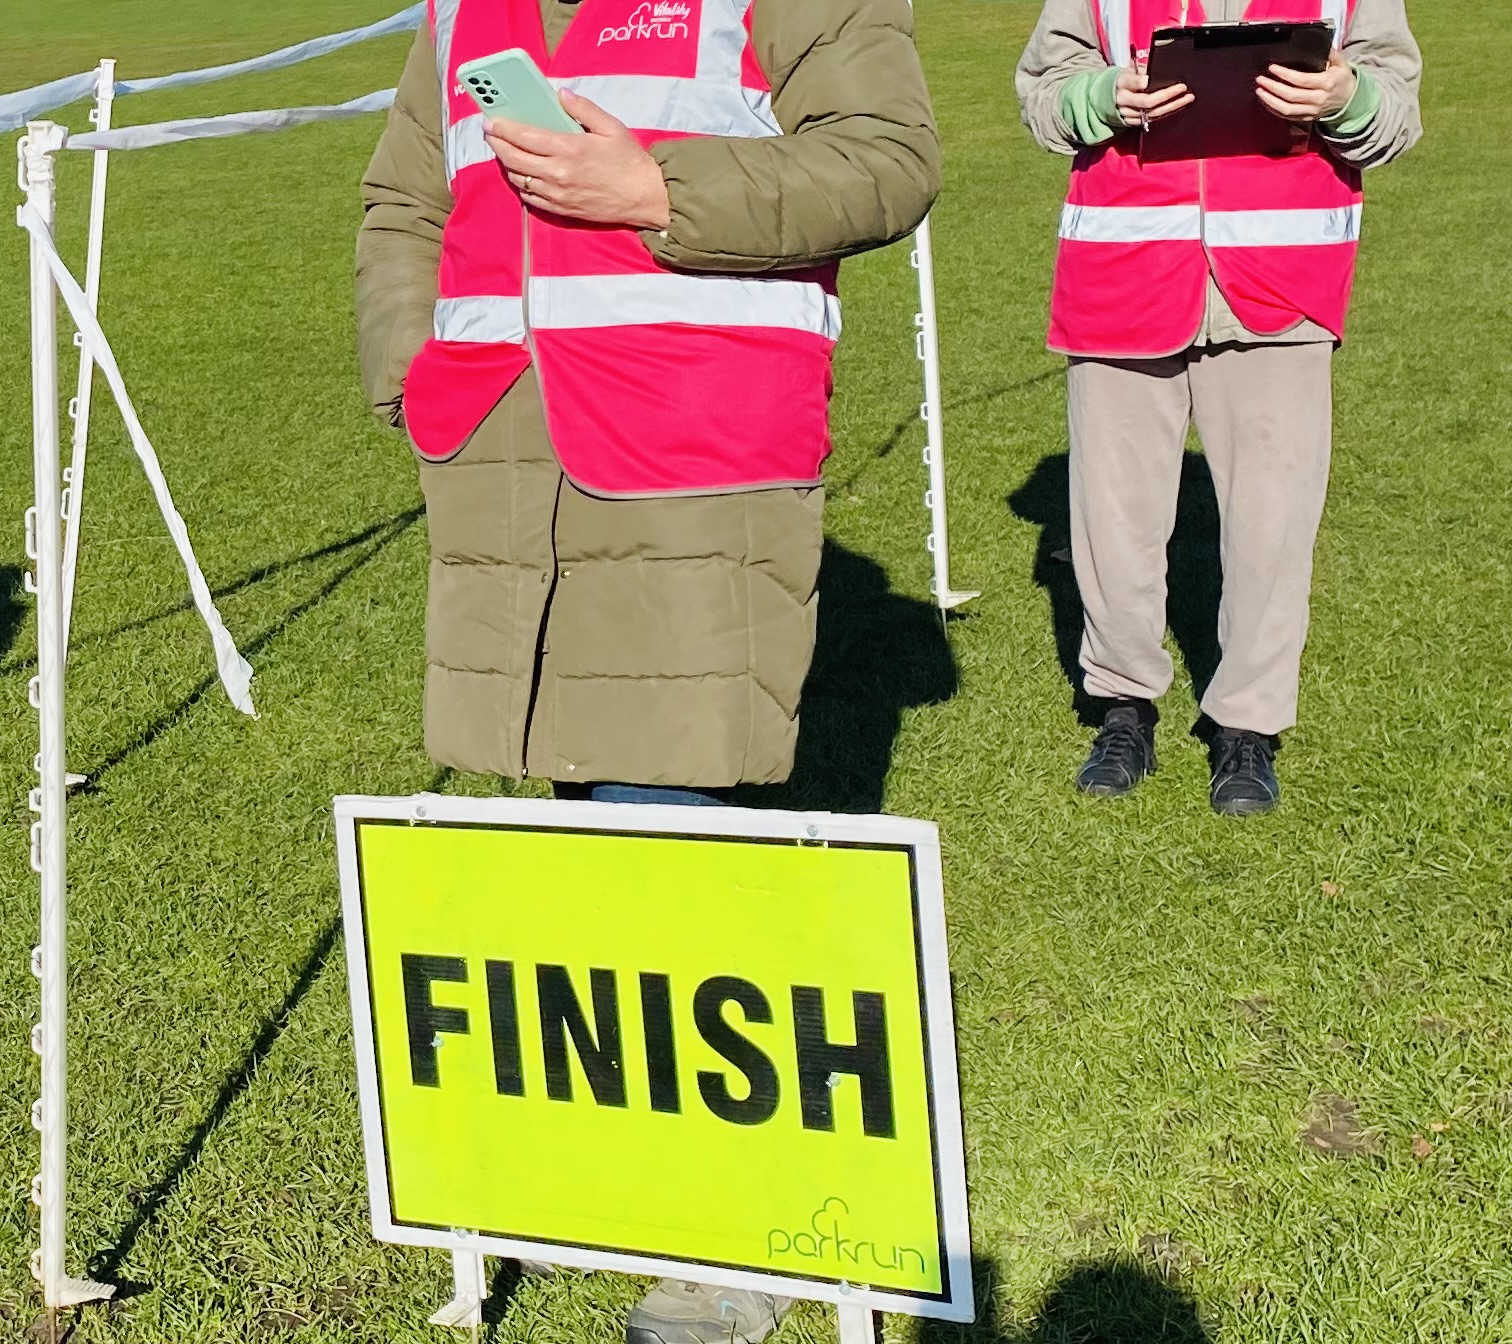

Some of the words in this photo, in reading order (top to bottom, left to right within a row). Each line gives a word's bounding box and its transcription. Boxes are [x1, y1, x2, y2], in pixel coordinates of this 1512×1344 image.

[597, 14, 688, 47] parkrun
[399, 951, 899, 1141] FINISH
[767, 1218, 926, 1275] parkrun
